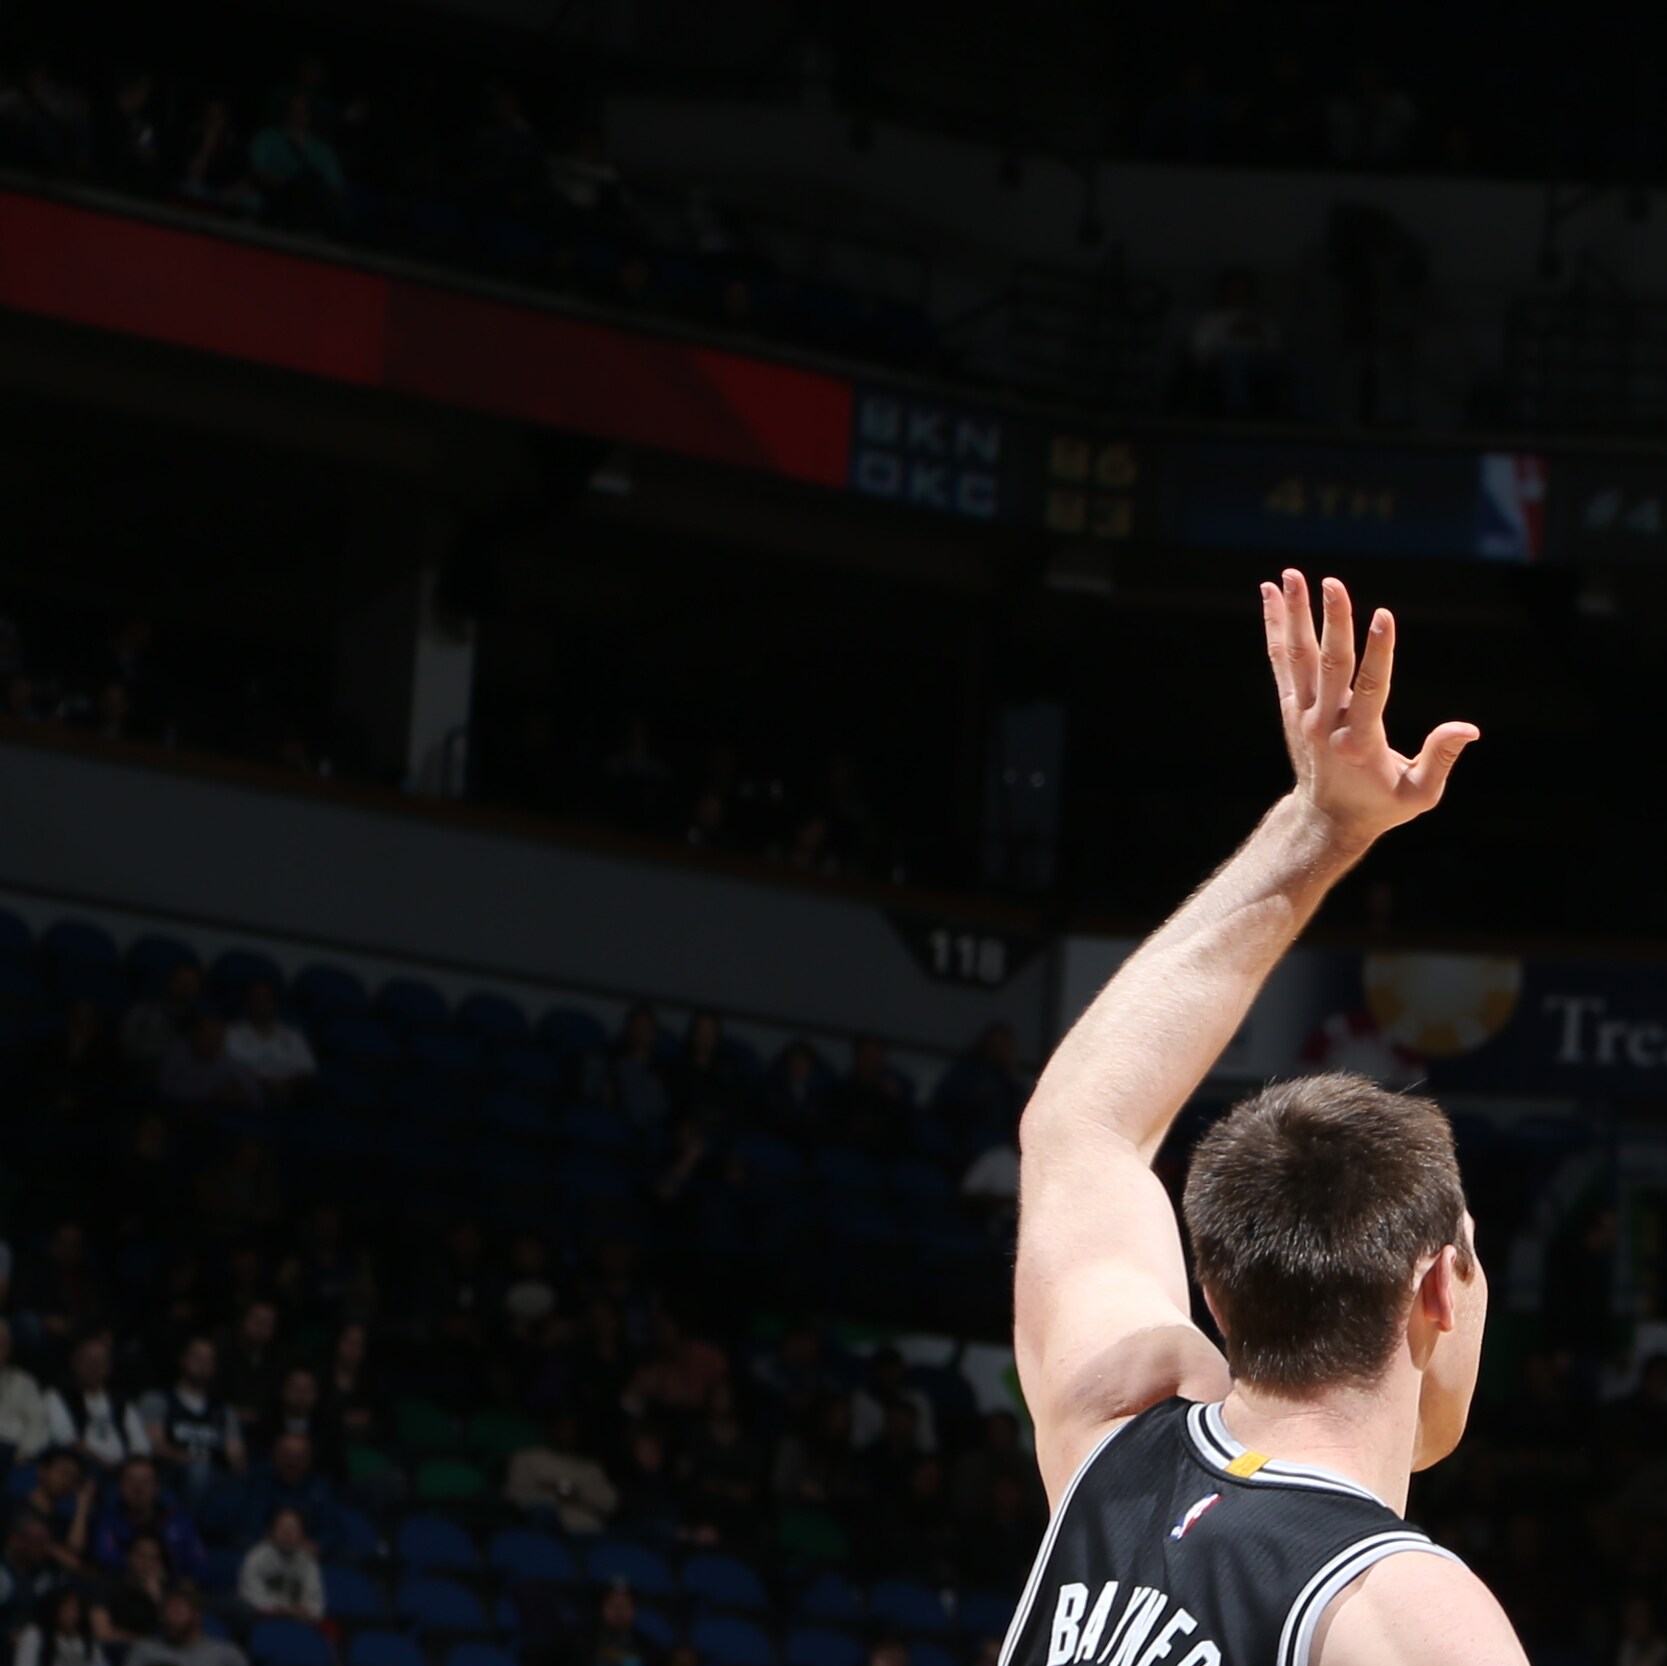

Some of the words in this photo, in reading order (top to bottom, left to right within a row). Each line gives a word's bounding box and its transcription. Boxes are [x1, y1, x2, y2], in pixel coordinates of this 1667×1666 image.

[859, 394, 1002, 465] BKN
[856, 447, 1000, 522] OKC
[1264, 476, 1395, 522] 4TH
